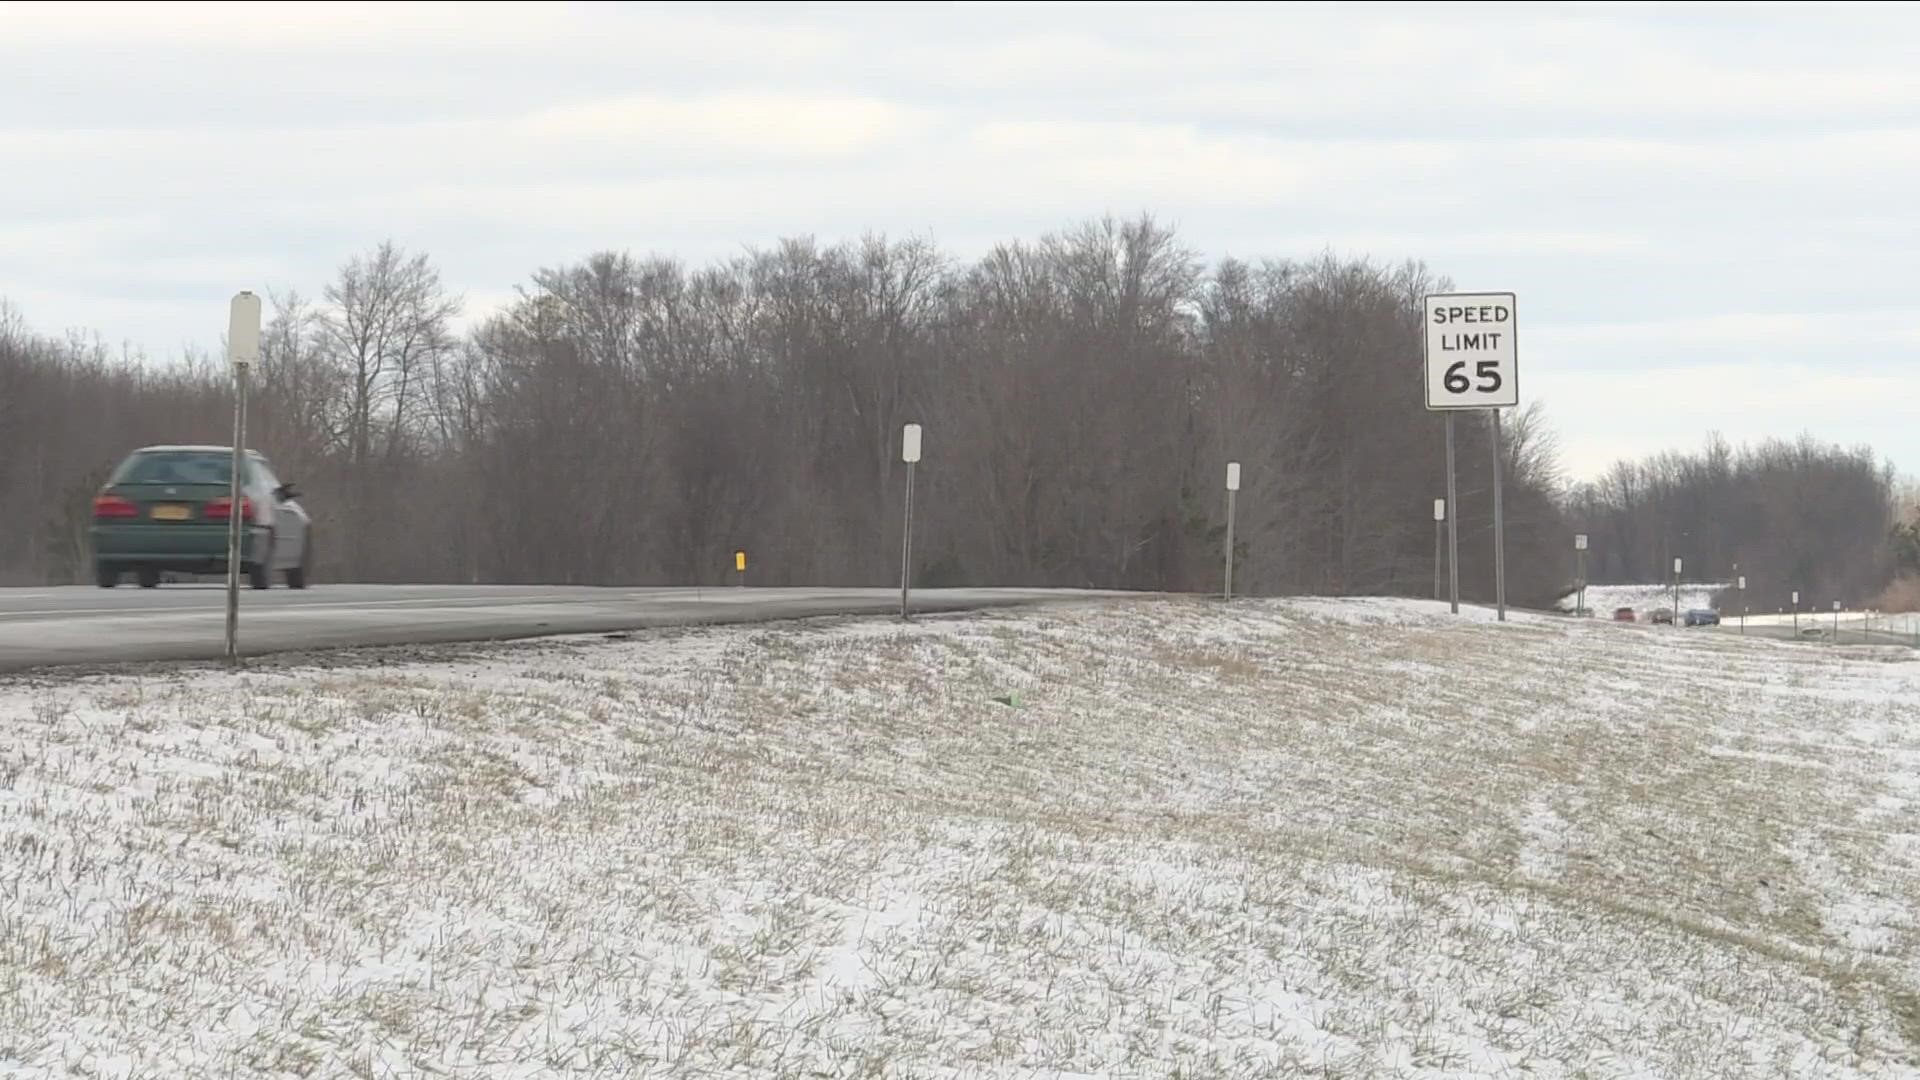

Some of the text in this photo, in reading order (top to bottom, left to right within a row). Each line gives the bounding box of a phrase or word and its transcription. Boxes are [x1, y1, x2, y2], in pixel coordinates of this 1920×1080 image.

[1433, 305, 1509, 324] SPEED
[1442, 333, 1502, 351] LIMIT
[1443, 360, 1502, 394] 65
